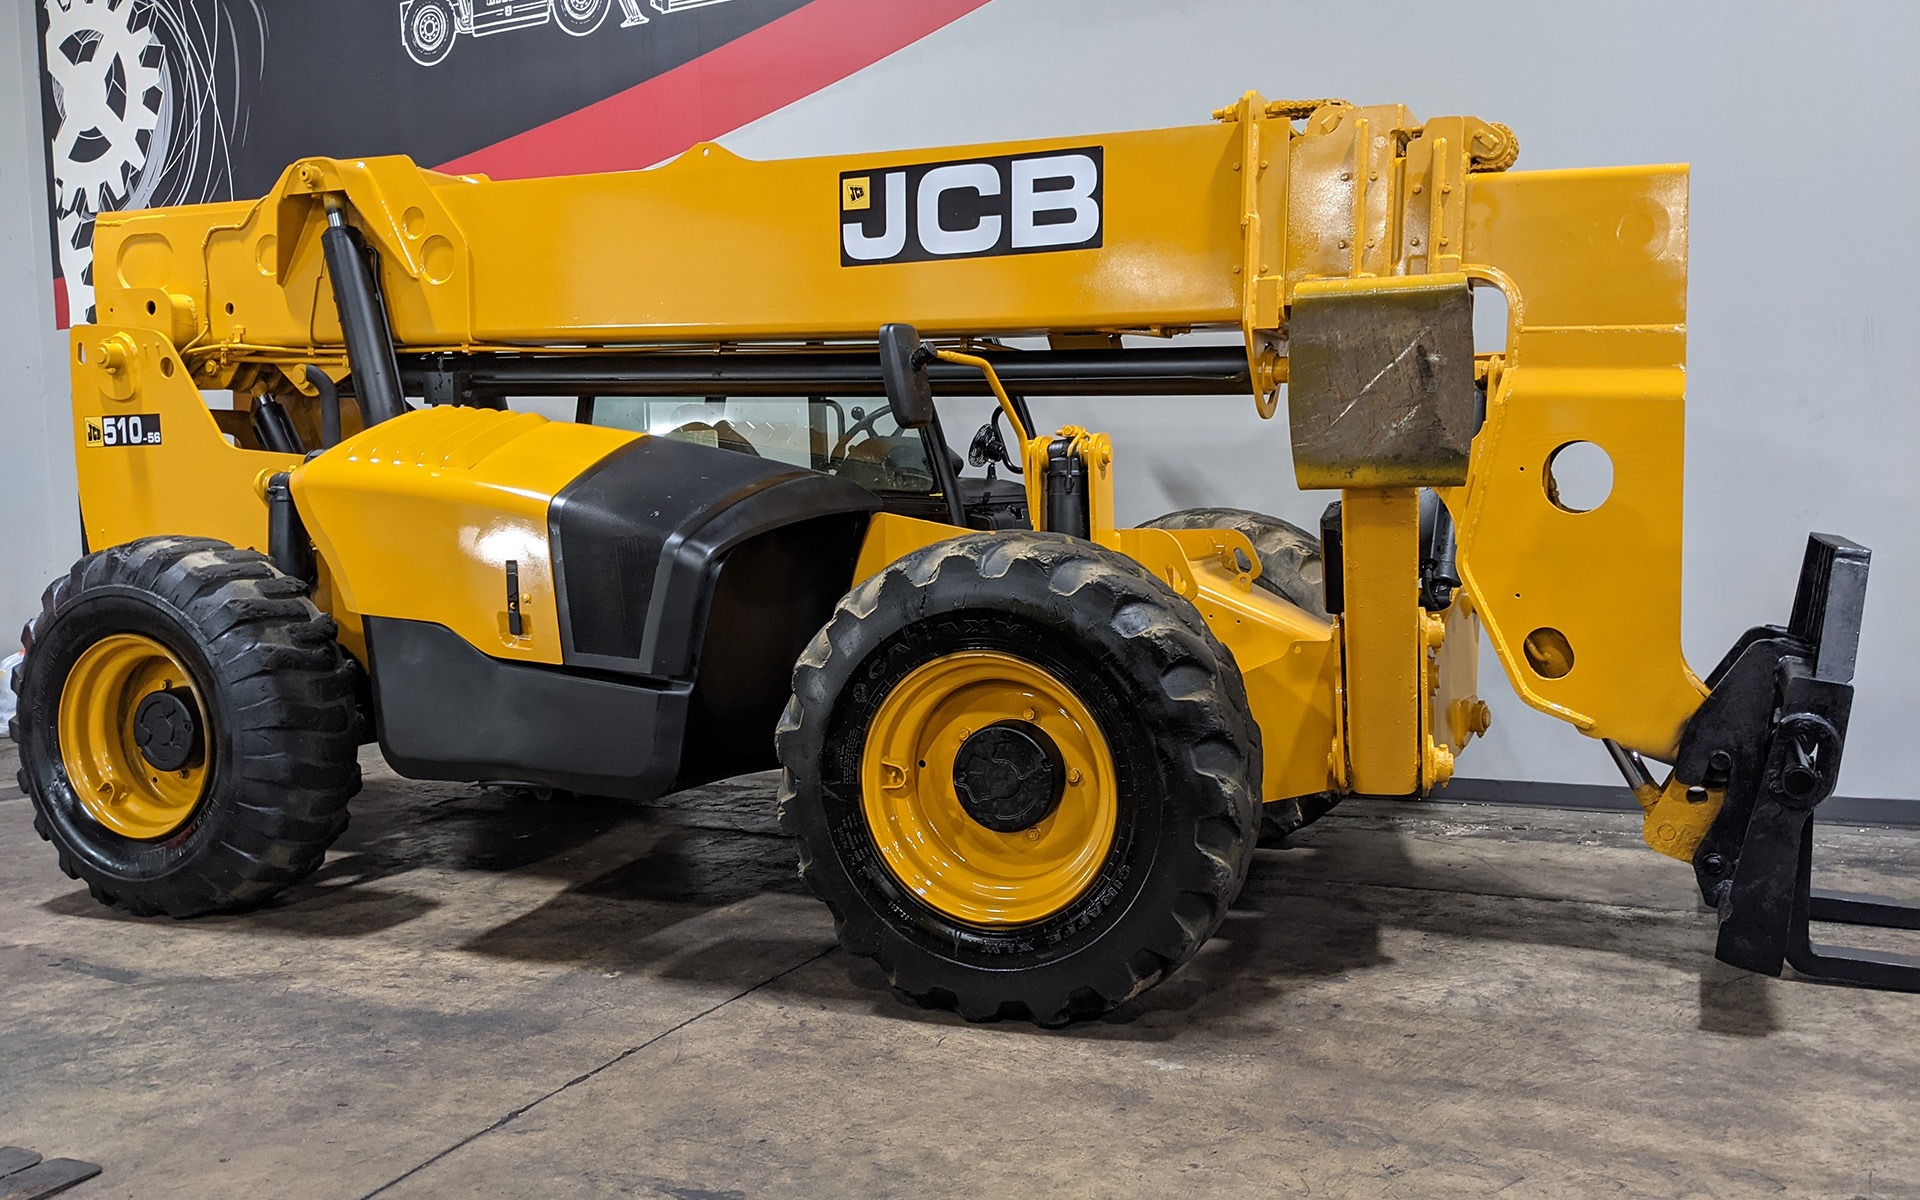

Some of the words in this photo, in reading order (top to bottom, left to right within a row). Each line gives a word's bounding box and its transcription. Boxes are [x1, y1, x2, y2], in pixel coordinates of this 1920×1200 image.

[843, 154, 1100, 260] JCB
[849, 186, 865, 201] JCB
[87, 423, 102, 442] JCB
[1046, 864, 1132, 947] GIRAFFE
